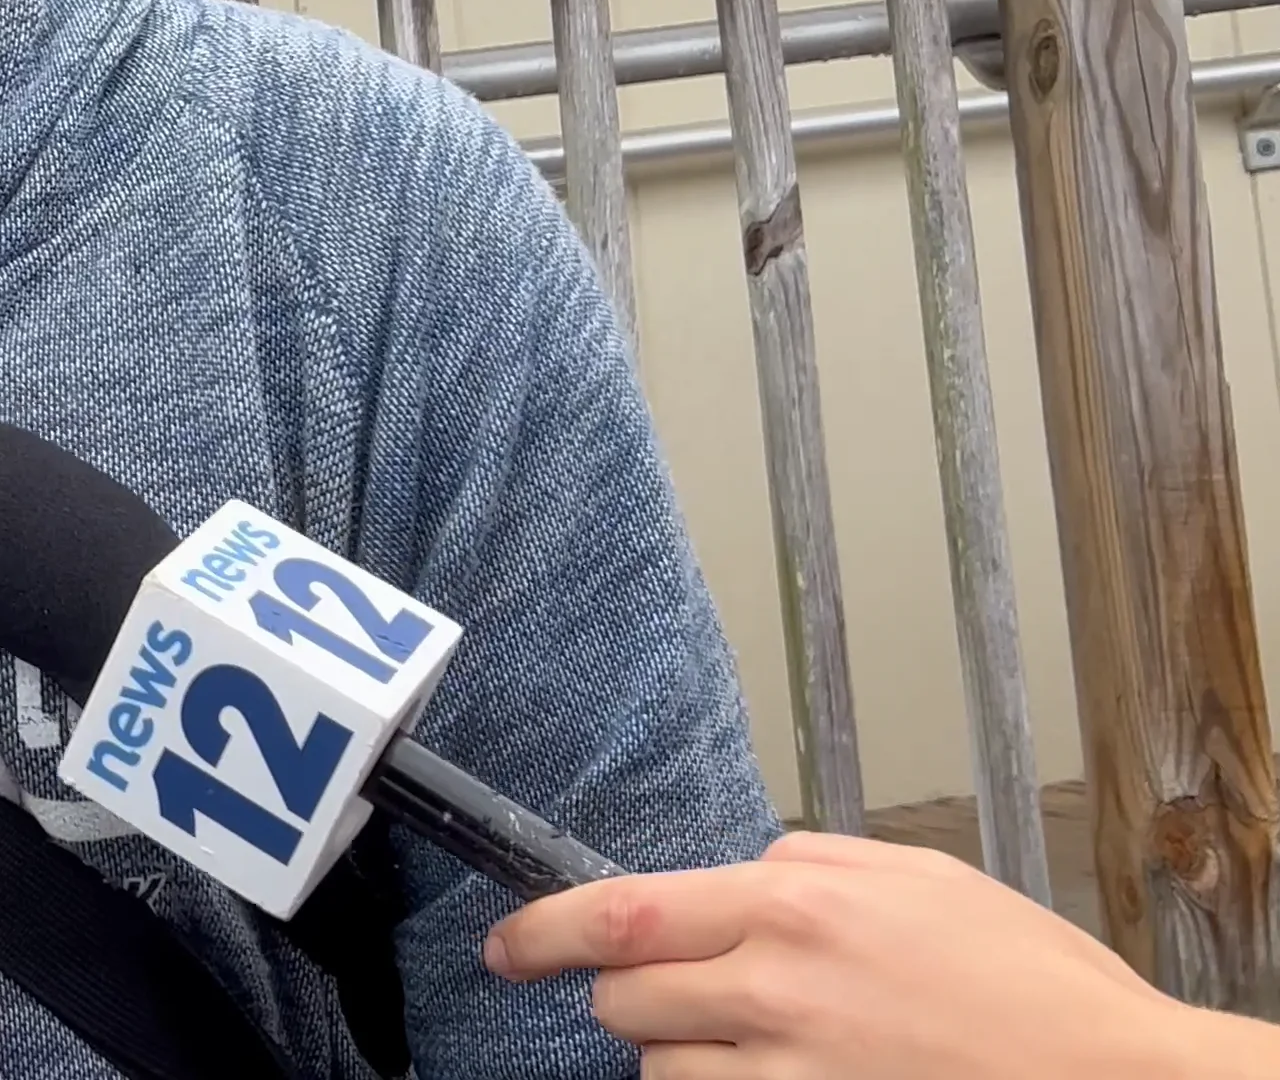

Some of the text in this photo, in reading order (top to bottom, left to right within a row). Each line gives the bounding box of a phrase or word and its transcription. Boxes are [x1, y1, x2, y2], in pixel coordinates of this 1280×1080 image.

[180, 520, 281, 602] news
[248, 557, 435, 684] 12
[86, 620, 193, 792] news
[152, 663, 355, 867] 12
